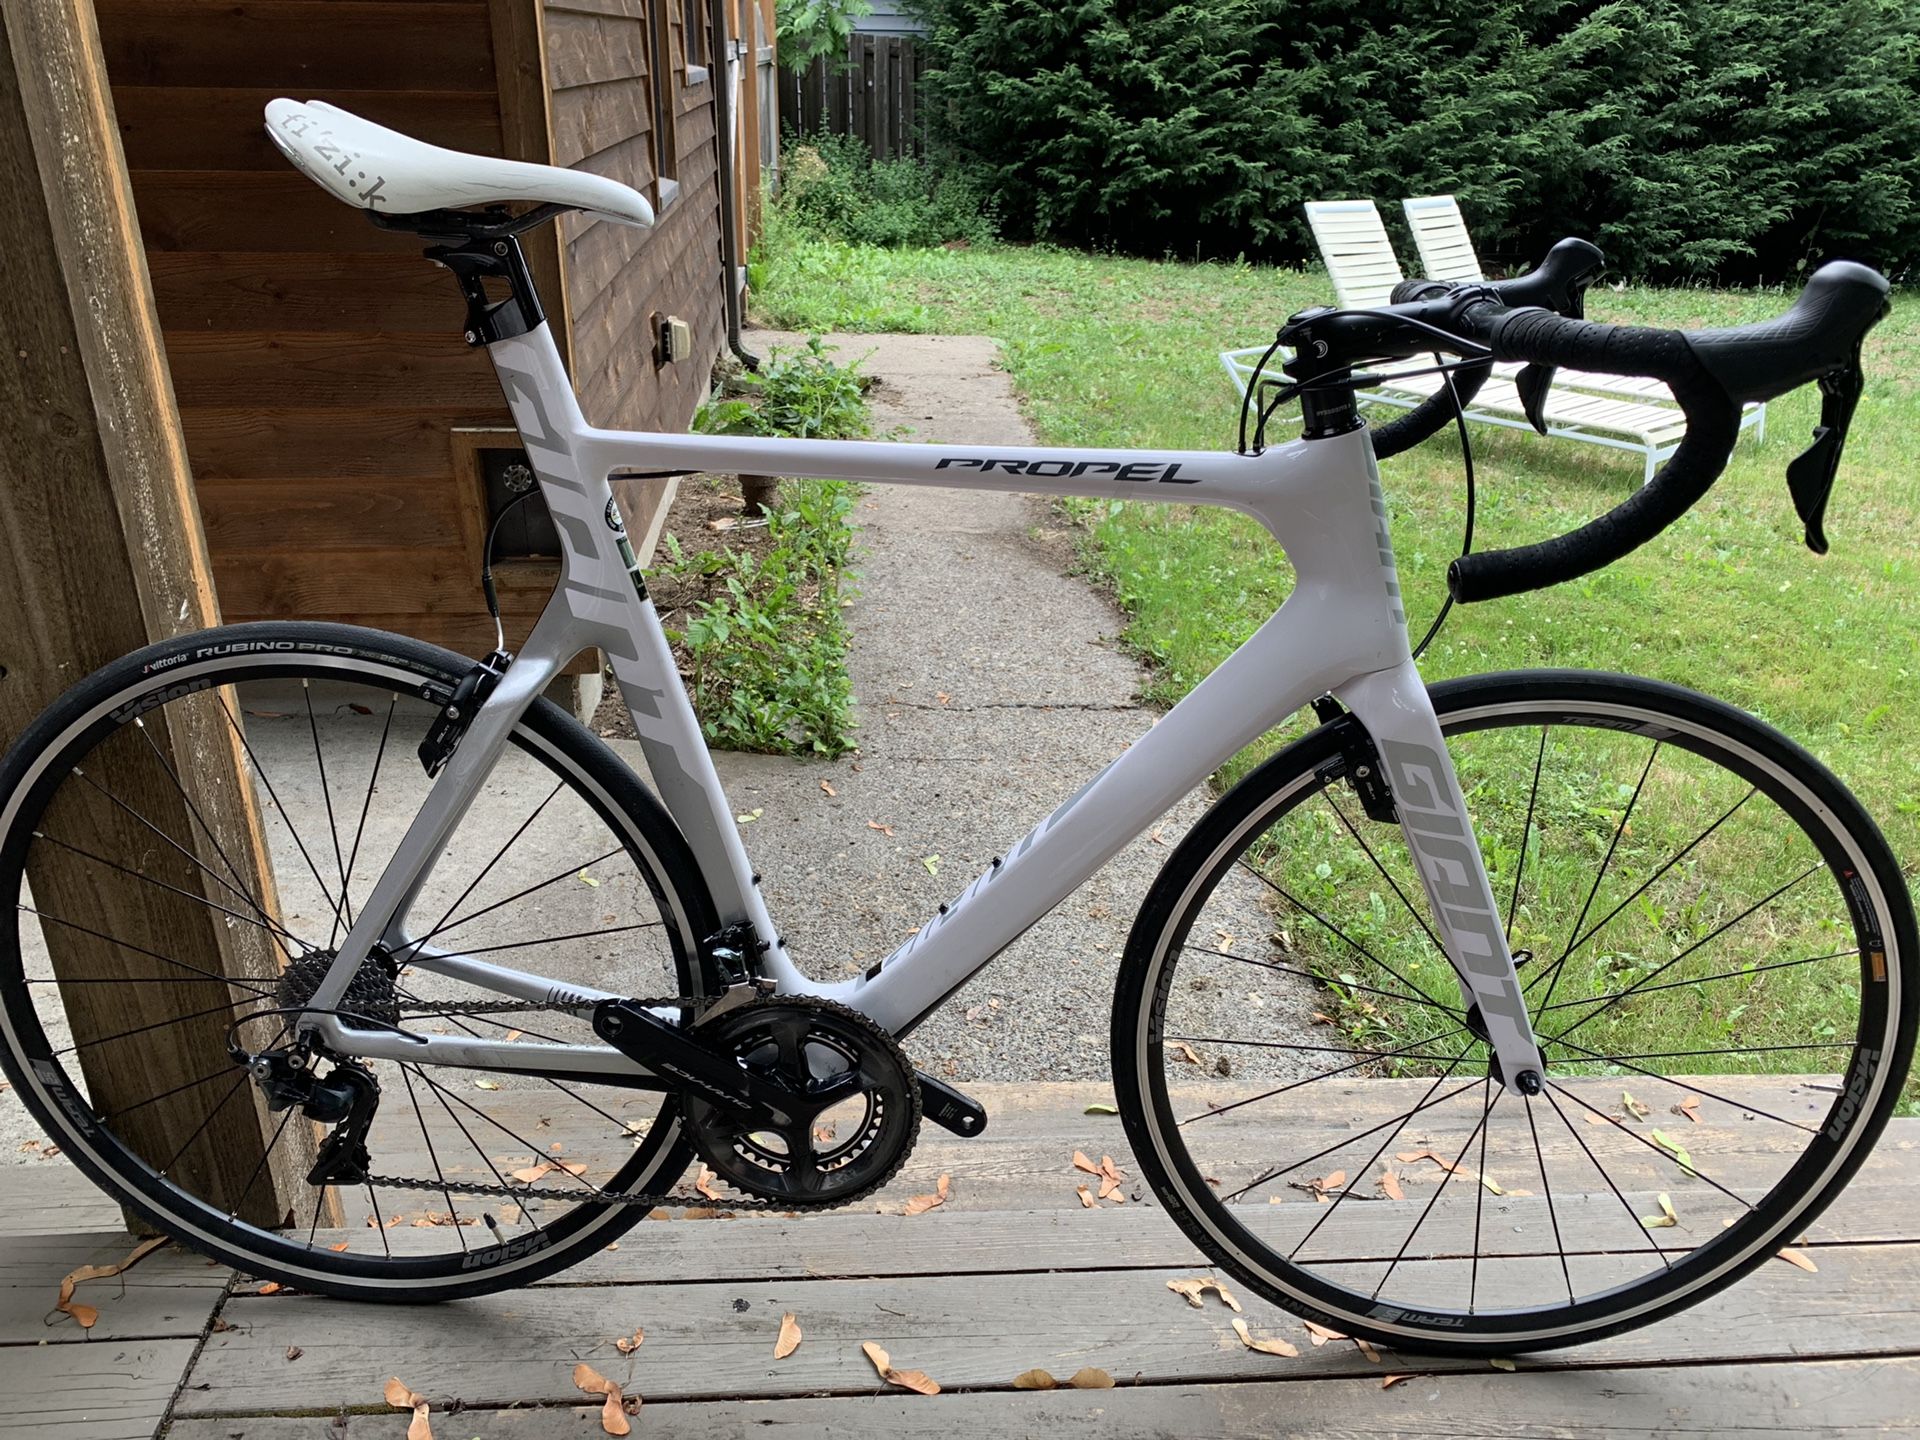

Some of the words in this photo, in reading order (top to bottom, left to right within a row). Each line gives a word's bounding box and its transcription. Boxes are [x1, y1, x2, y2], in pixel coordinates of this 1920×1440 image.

[935, 457, 1202, 485] PROPEL
[197, 641, 296, 658] RUBINO
[298, 642, 353, 655] PRO
[1381, 739, 1534, 1047] GIANT
